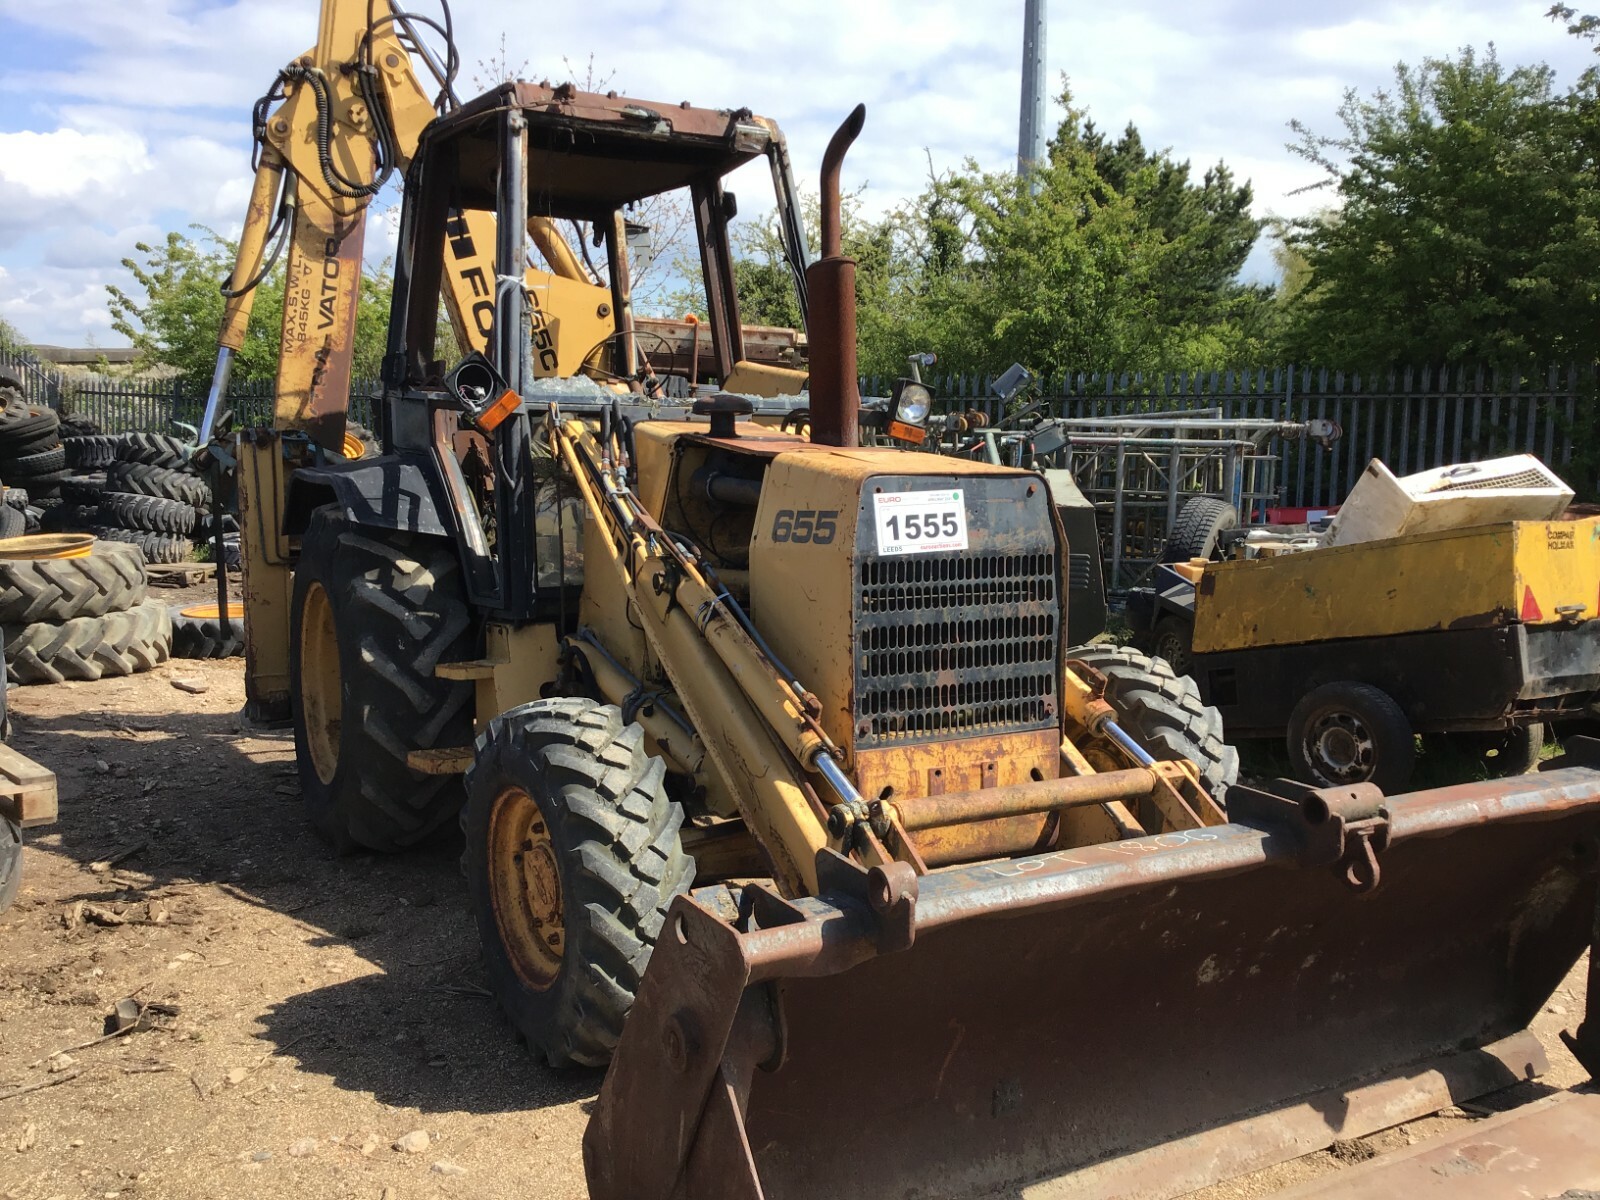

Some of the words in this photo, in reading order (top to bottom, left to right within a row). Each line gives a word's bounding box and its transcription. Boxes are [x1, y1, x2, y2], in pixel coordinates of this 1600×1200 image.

[460, 266, 496, 338] FO
[878, 496, 902, 504] EURO
[771, 509, 839, 545] 655
[886, 512, 959, 541] 1555
[882, 545, 903, 553] LEEDS
[985, 852, 1087, 877] LOT
